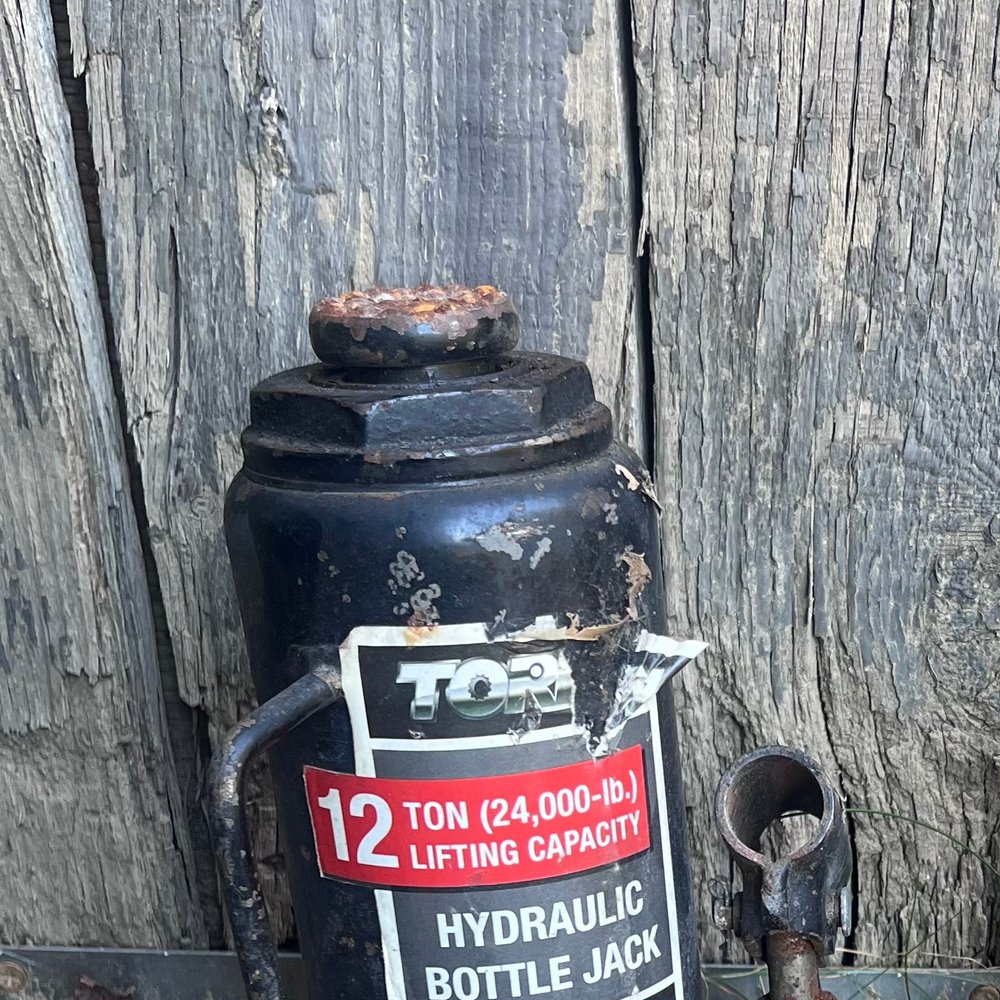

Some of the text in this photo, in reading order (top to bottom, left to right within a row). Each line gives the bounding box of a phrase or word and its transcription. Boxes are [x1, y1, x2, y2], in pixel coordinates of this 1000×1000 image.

[318, 770, 639, 869] 12 TON (24,000-lb.)
[409, 810, 641, 870] LIFTING CAPACITY
[438, 881, 642, 947] HYDRAULIC
[426, 925, 660, 1000] BOTTLE JACK
